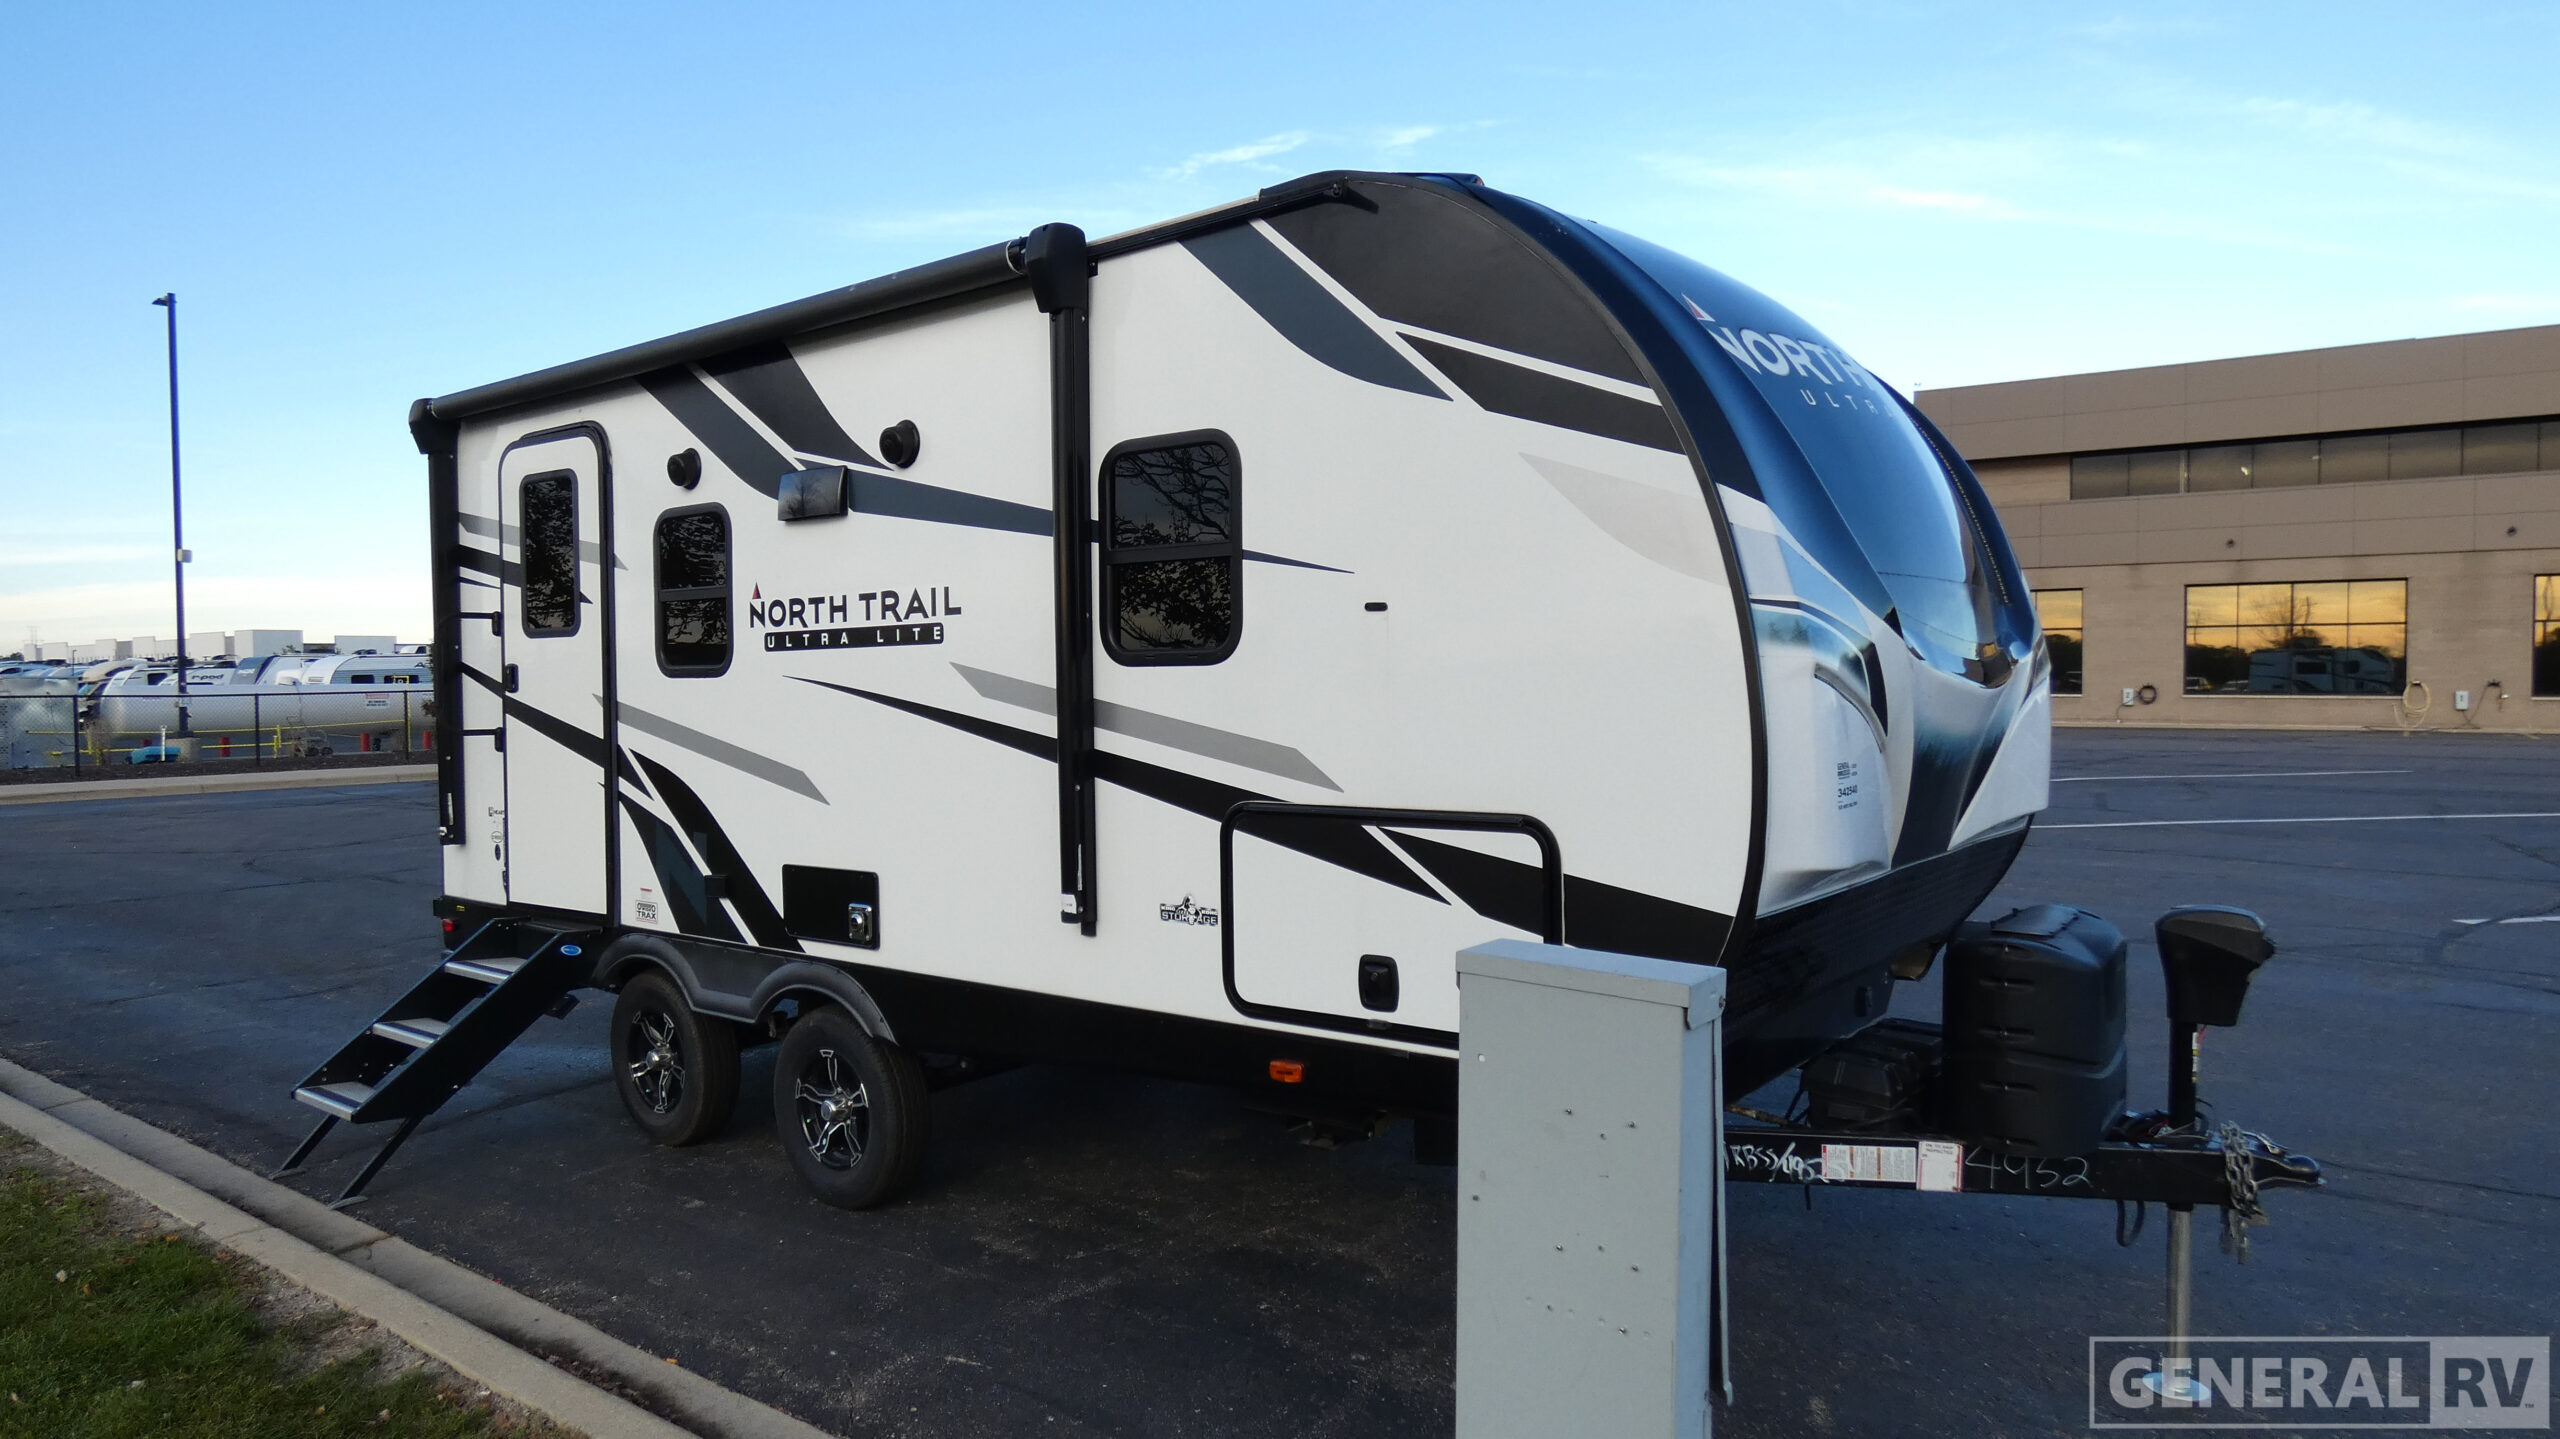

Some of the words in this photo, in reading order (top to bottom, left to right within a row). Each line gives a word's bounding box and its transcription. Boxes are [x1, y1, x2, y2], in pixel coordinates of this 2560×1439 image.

[1800, 389, 1895, 417] ULTR
[750, 594, 848, 629] NORTH
[858, 586, 962, 622] TRAIL
[767, 631, 849, 649] ULTRA
[876, 626, 941, 643] LITE
[1965, 1145, 2095, 1190] 4952
